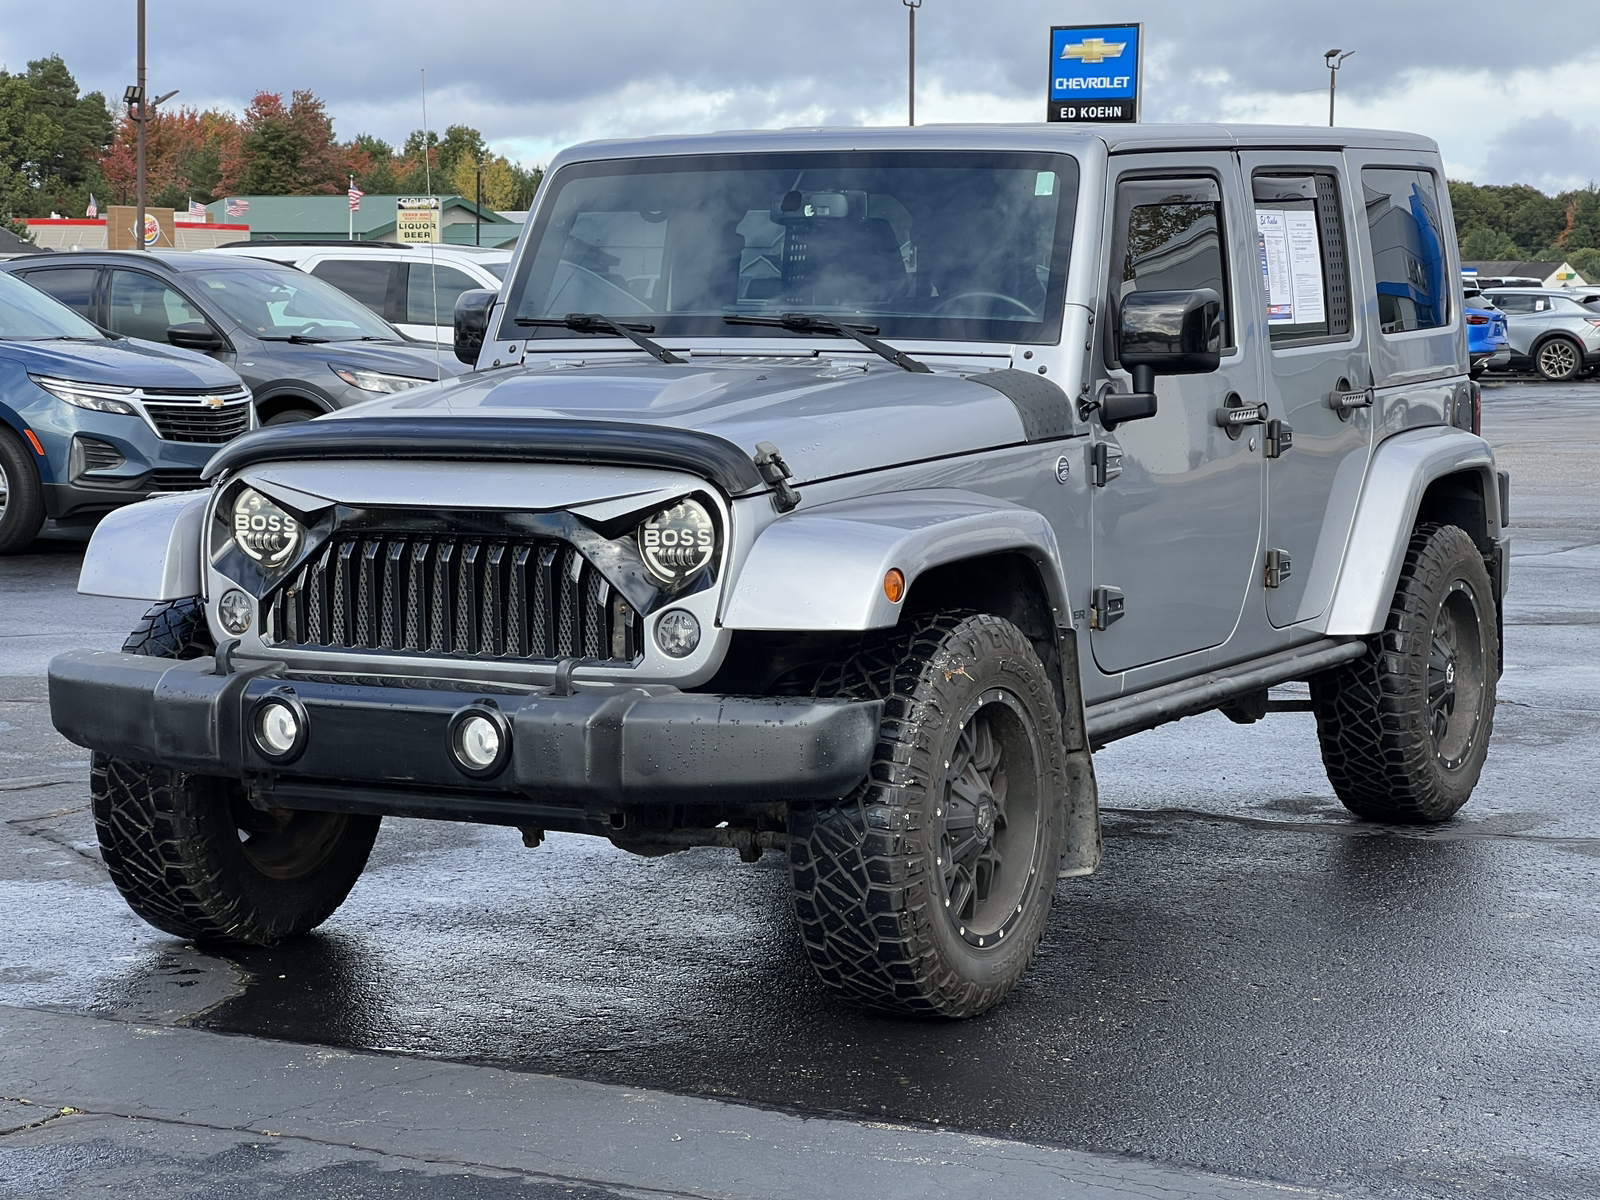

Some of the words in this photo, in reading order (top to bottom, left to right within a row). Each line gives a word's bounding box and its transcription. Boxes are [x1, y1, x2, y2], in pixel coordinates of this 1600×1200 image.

[1055, 76, 1130, 90] CHEVROLET
[1060, 107, 1076, 118] ED
[1080, 106, 1122, 118] KOEHN
[404, 231, 430, 239] BEER
[235, 514, 297, 532] BOSS
[644, 528, 712, 547] BOSS
